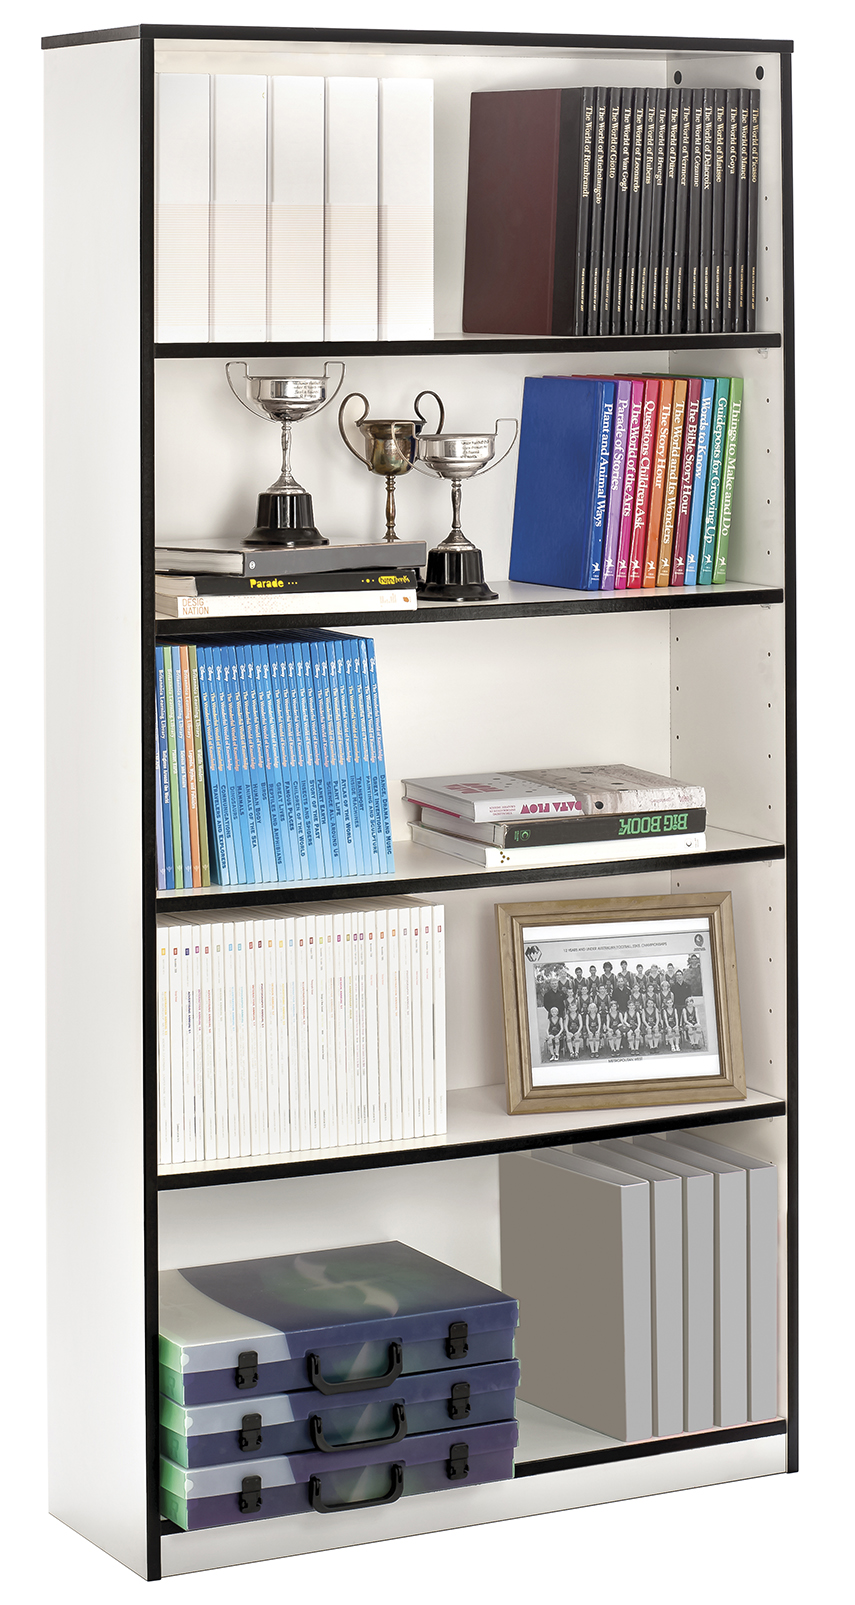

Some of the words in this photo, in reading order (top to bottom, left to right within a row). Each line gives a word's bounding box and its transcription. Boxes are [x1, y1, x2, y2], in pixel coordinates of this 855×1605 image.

[611, 105, 619, 121] The
[584, 121, 592, 143] World
[583, 144, 591, 154] of
[597, 144, 604, 153] of
[610, 144, 617, 154] of
[622, 146, 629, 156] of
[634, 146, 641, 156] of
[646, 146, 653, 156] of
[657, 146, 664, 156] of
[669, 146, 676, 156] of
[681, 145, 688, 154] of
[694, 145, 701, 155] of
[704, 144, 711, 153] of
[716, 145, 723, 154] of
[729, 145, 736, 153] of
[740, 146, 747, 155] of
[751, 146, 758, 154] of
[608, 153, 616, 178] Giotto
[632, 156, 641, 192] Leonardo
[654, 156, 664, 185] Bruegel
[680, 154, 688, 186] Vermeer
[703, 153, 711, 189] Delacroix
[727, 154, 736, 174] Goya
[582, 154, 590, 197] Rembrandt
[593, 154, 603, 204] Michelangelo
[618, 170, 628, 191] Gogh
[602, 403, 613, 433] Plant
[615, 399, 628, 437] Parade
[631, 401, 641, 424] The
[660, 403, 670, 426] The
[674, 400, 684, 423] The
[688, 399, 699, 422] The
[699, 397, 710, 430] Words
[728, 400, 741, 441] Things
[641, 400, 655, 455] Questions
[686, 424, 696, 452] Bible
[698, 431, 705, 444] to
[713, 397, 727, 458] Guideposts
[600, 433, 609, 455] and
[614, 439, 624, 452] of
[627, 423, 639, 459] World
[656, 427, 668, 457] Story
[671, 425, 682, 456] World
[728, 443, 736, 455] to
[610, 452, 623, 490] Stories
[626, 458, 636, 472] of
[669, 458, 677, 479] and
[681, 453, 694, 483] Story
[695, 444, 706, 478] Know
[712, 459, 721, 475] for
[597, 456, 608, 498] Animal
[624, 471, 635, 492] the
[637, 456, 650, 505] Children
[655, 458, 665, 488] Hour
[725, 456, 736, 490] Make
[668, 481, 677, 494] Its
[622, 491, 633, 517] Arts
[681, 484, 691, 514] Hour
[705, 476, 720, 525] Growing
[593, 500, 605, 526] Ways
[635, 506, 645, 528] Ask
[663, 496, 675, 543] Wonders
[704, 524, 715, 543] Up
[721, 516, 730, 535] Do
[250, 578, 284, 588] Parade
[182, 598, 204, 607] DESIG
[182, 606, 209, 615] NATION
[520, 802, 550, 814] FLOW
[552, 801, 582, 812] DATA
[618, 816, 662, 835] BOOK
